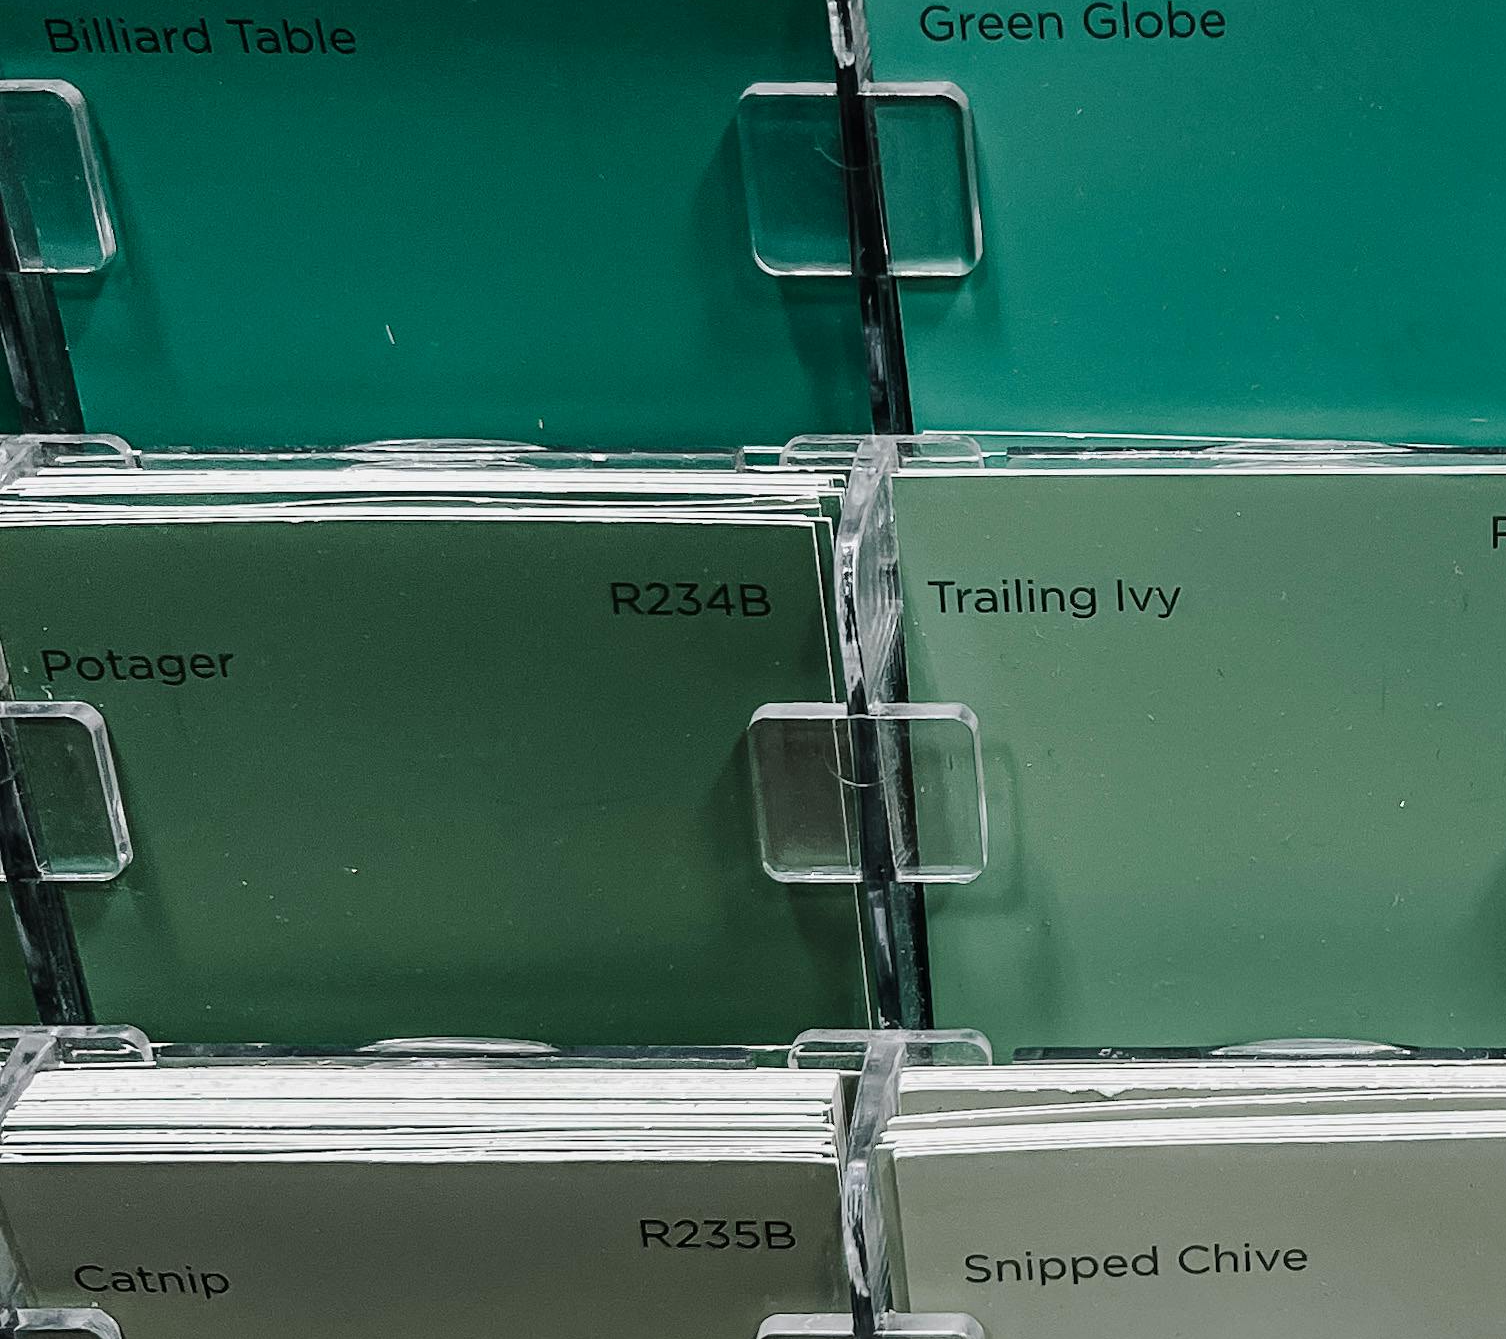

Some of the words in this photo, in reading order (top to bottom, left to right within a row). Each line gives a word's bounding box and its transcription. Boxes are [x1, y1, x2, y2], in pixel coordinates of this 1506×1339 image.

[44, 17, 212, 54] Billiard
[225, 18, 356, 55] Table
[919, 4, 1064, 42] Green
[1083, 0, 1226, 39] Globe
[610, 582, 772, 617] R234B
[927, 578, 1097, 619] Trailing
[1116, 579, 1181, 619] Ivy
[41, 649, 234, 686] Potager
[639, 1219, 796, 1250] R235B
[73, 1265, 230, 1300] Catnip
[965, 1245, 1159, 1286] Snipped
[1178, 1243, 1308, 1275] Chive
